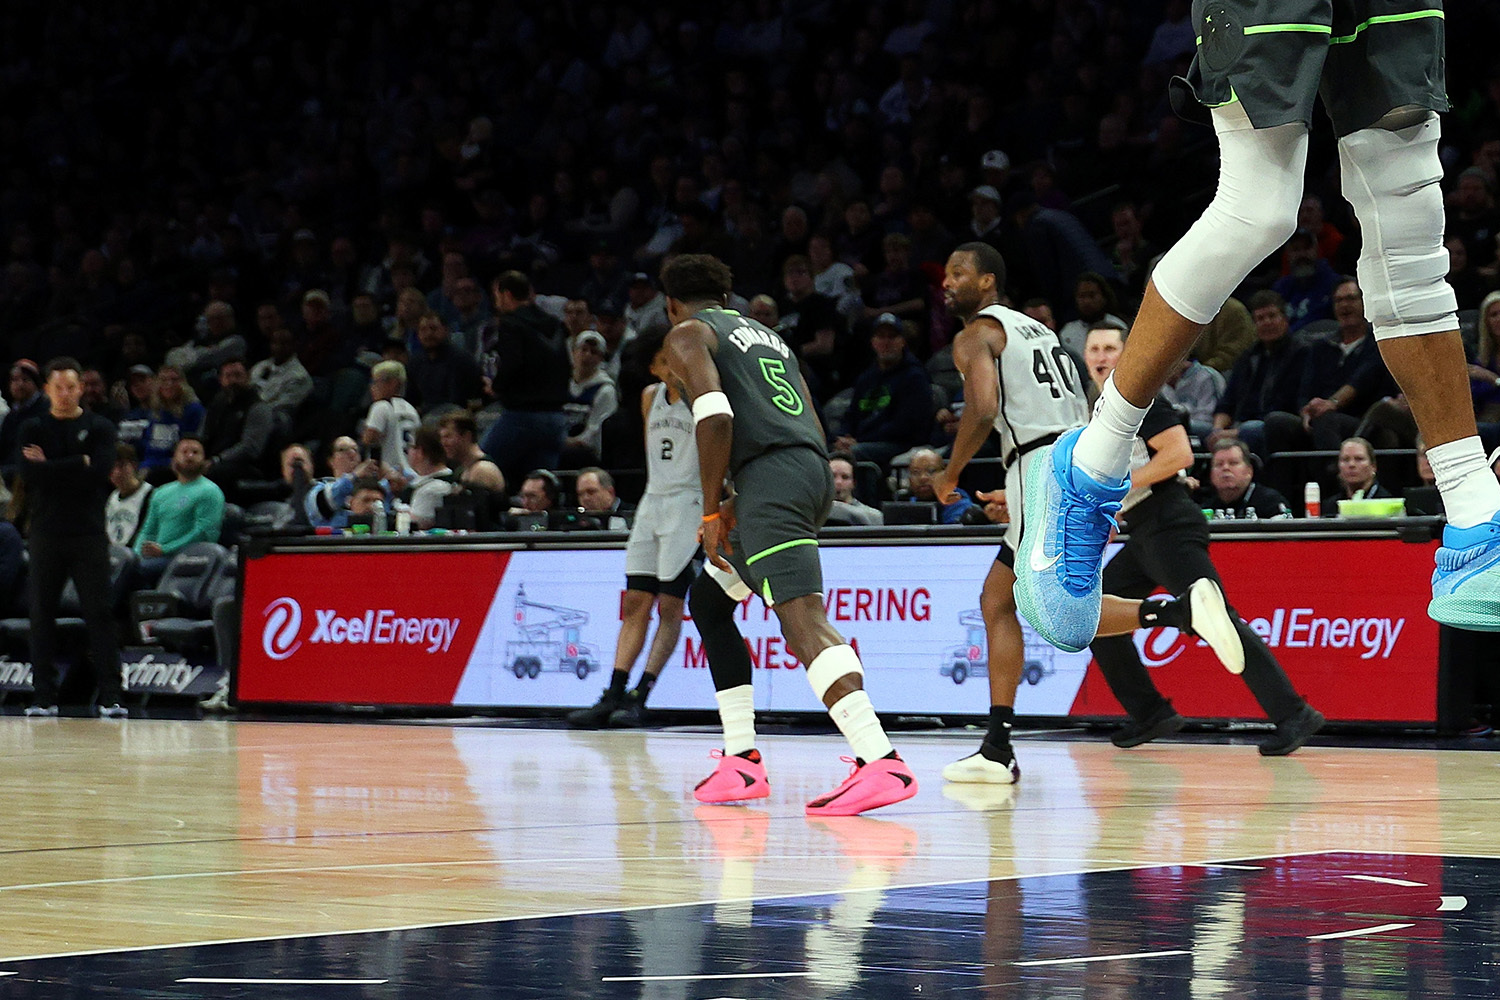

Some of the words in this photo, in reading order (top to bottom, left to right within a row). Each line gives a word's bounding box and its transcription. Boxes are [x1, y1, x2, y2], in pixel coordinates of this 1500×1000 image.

[758, 357, 805, 417] 5
[1033, 346, 1077, 399] 40
[661, 438, 673, 460] 2
